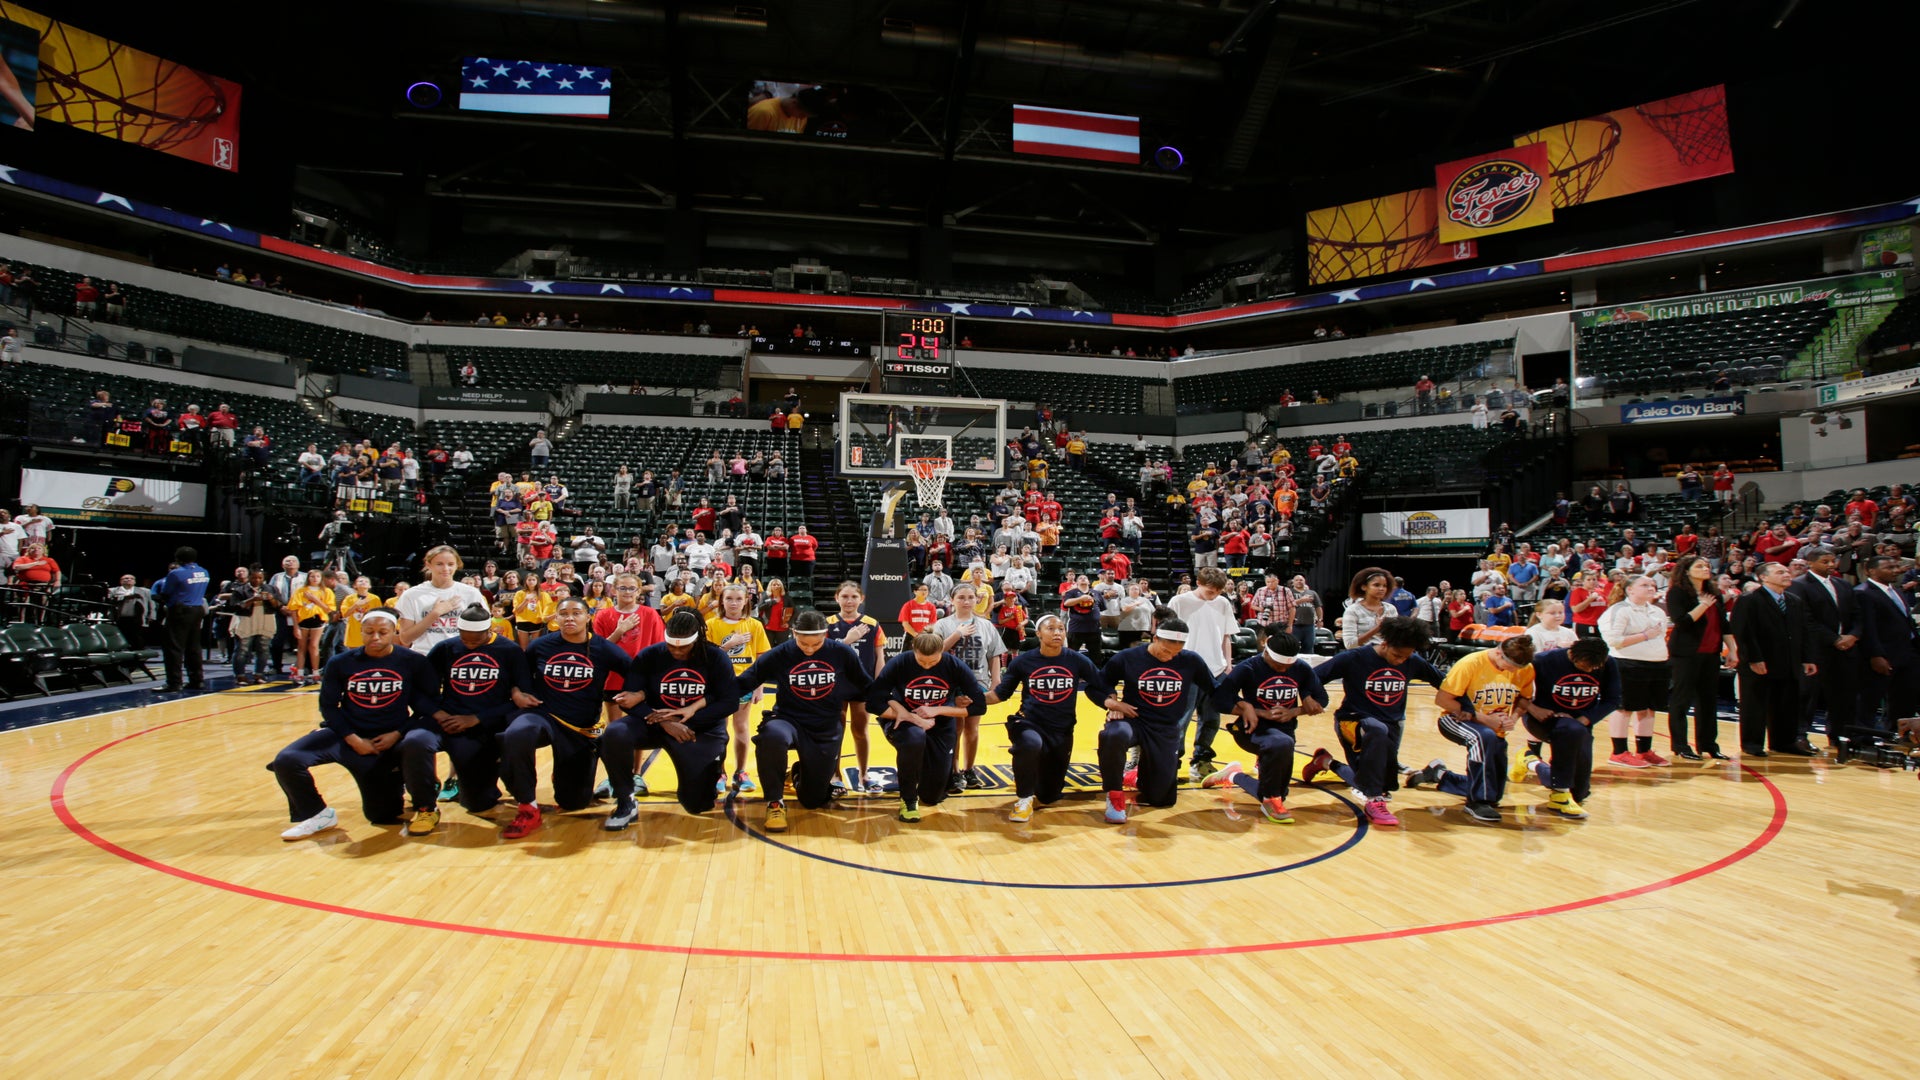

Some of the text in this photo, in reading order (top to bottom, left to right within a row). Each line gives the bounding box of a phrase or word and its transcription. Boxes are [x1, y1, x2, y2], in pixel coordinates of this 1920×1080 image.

[1459, 166, 1521, 189] INDIANA
[1450, 173, 1541, 221] Fever
[1880, 271, 1896, 279] 101
[1657, 298, 1737, 320] CHARGED
[1756, 291, 1795, 308] DEW
[1582, 310, 1595, 318] 101
[912, 318, 944, 334] 1:00
[897, 333, 939, 359] 24
[904, 364, 950, 374] TISSOT
[1636, 401, 1744, 418] Lake City Bank
[1401, 520, 1447, 535] LOCKER
[870, 574, 903, 582] verizon
[450, 667, 500, 680] FEVER
[544, 664, 594, 678] FEVER
[789, 671, 836, 686] FEVER
[1028, 677, 1074, 689] FEVER
[347, 680, 403, 693] FEVER
[660, 682, 706, 695] FEVER
[1138, 679, 1183, 692] FEVER
[1365, 680, 1405, 692] FEVER
[1552, 684, 1600, 697] FEVER
[904, 688, 949, 700] FEVER
[1256, 687, 1298, 700] FEVER
